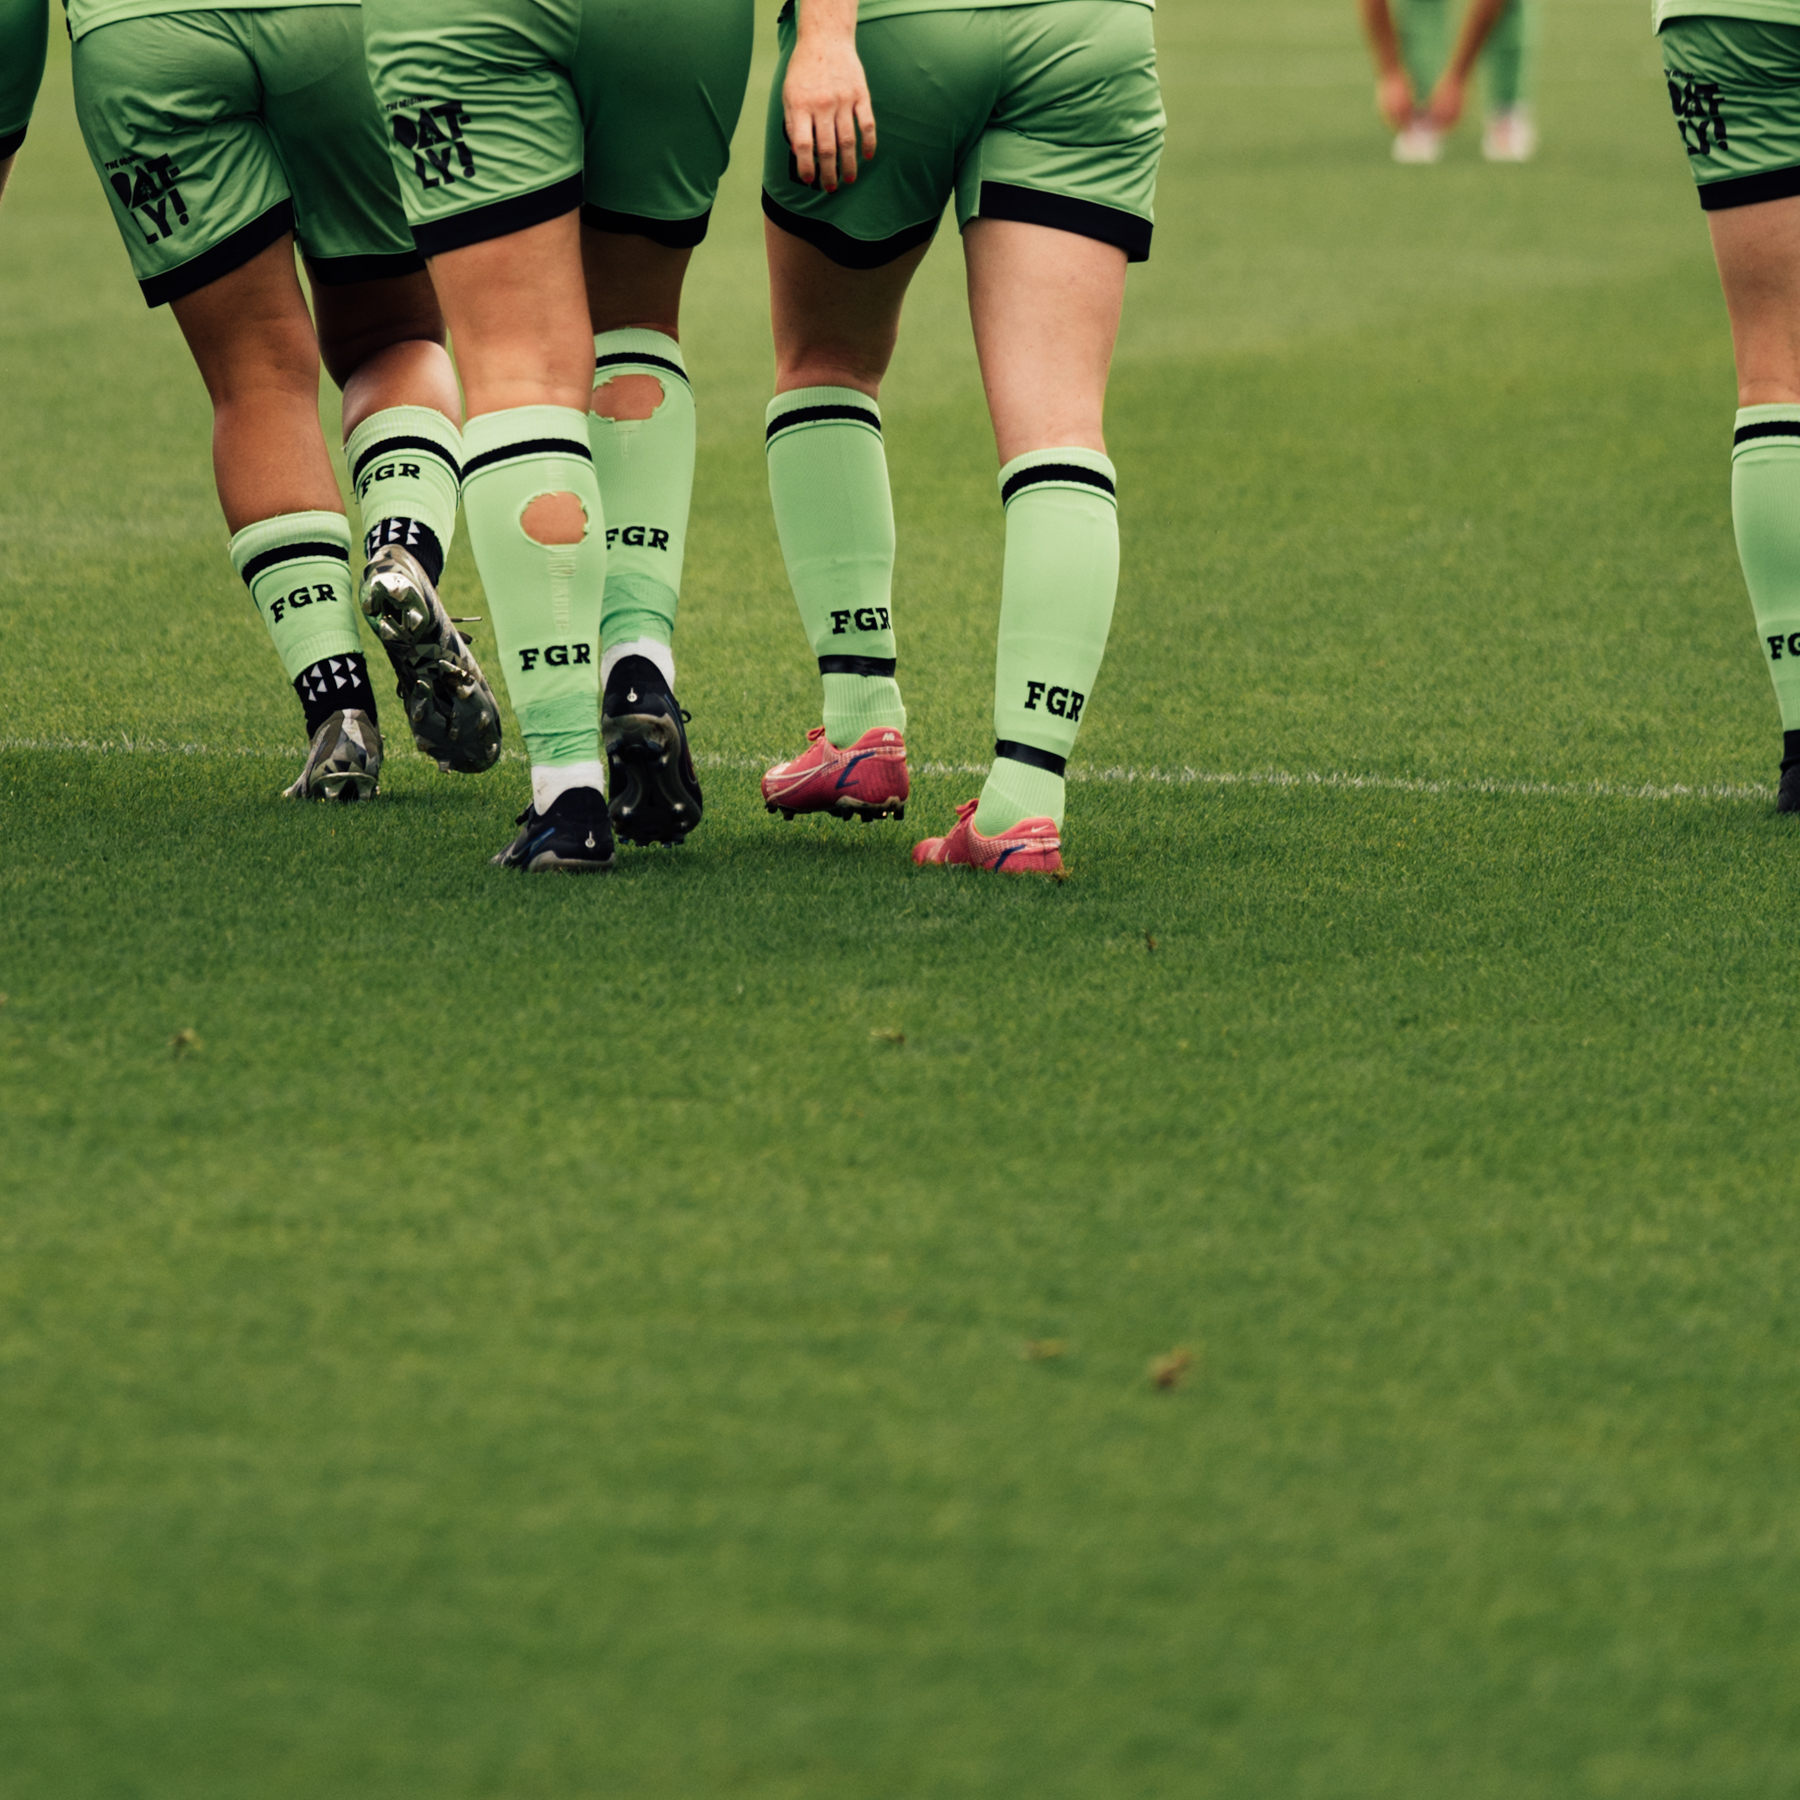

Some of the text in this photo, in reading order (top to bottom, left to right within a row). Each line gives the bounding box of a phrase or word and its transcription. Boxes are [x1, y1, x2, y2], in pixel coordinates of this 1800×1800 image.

[413, 140, 476, 190] LY!
[130, 187, 190, 245] LY!
[360, 461, 421, 499] FGR
[604, 524, 669, 551] FGR
[270, 582, 338, 624] FGR
[829, 606, 891, 635] FGR
[518, 642, 592, 672] FGR
[1023, 680, 1086, 723] FGR
